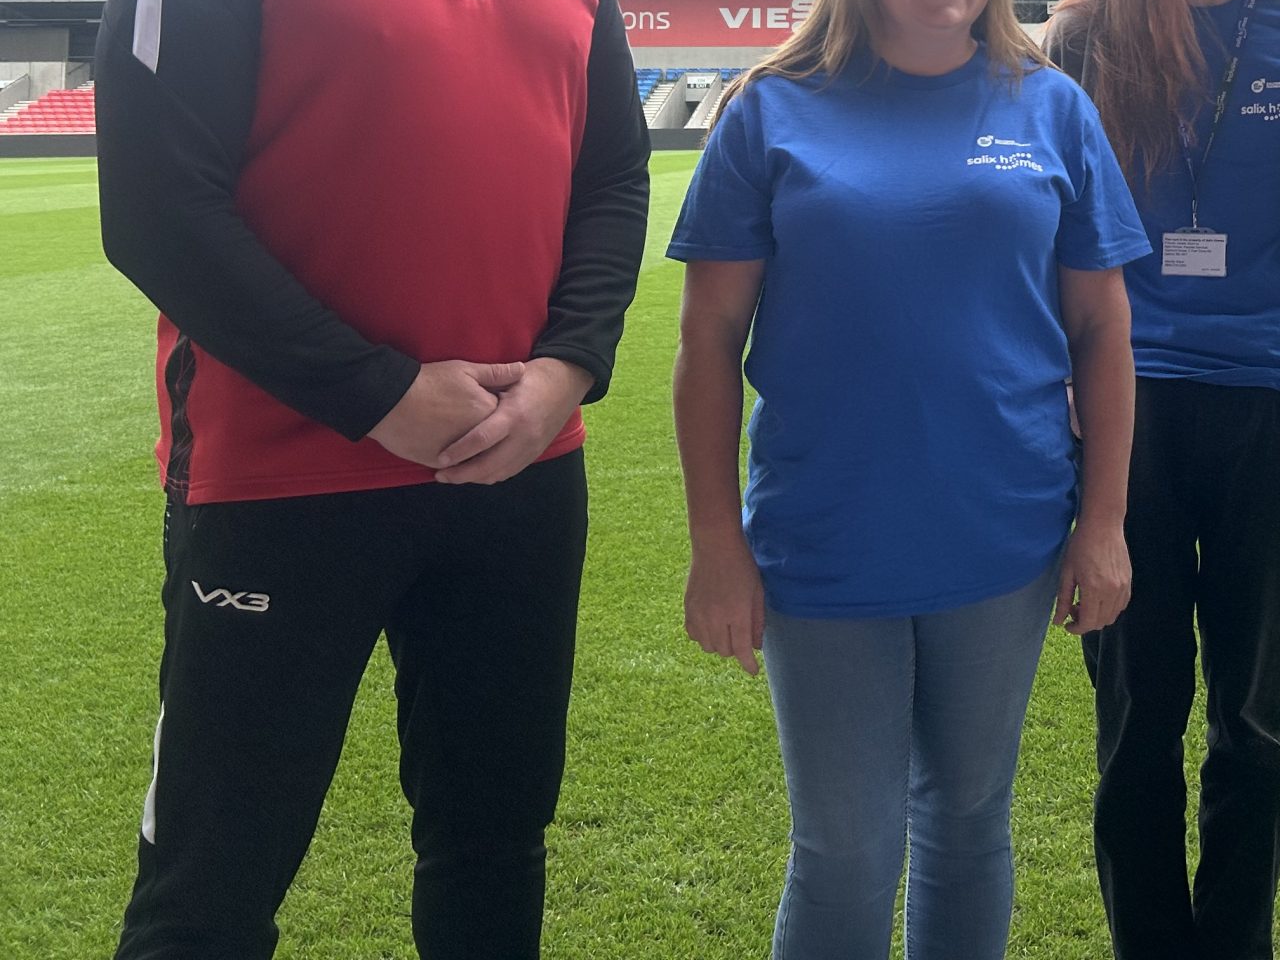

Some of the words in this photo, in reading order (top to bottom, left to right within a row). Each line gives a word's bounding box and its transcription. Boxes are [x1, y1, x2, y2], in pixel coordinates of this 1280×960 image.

[1241, 103, 1266, 115] salix
[967, 155, 997, 165] salix
[1000, 154, 1043, 172] homes
[191, 580, 270, 612] VX3
